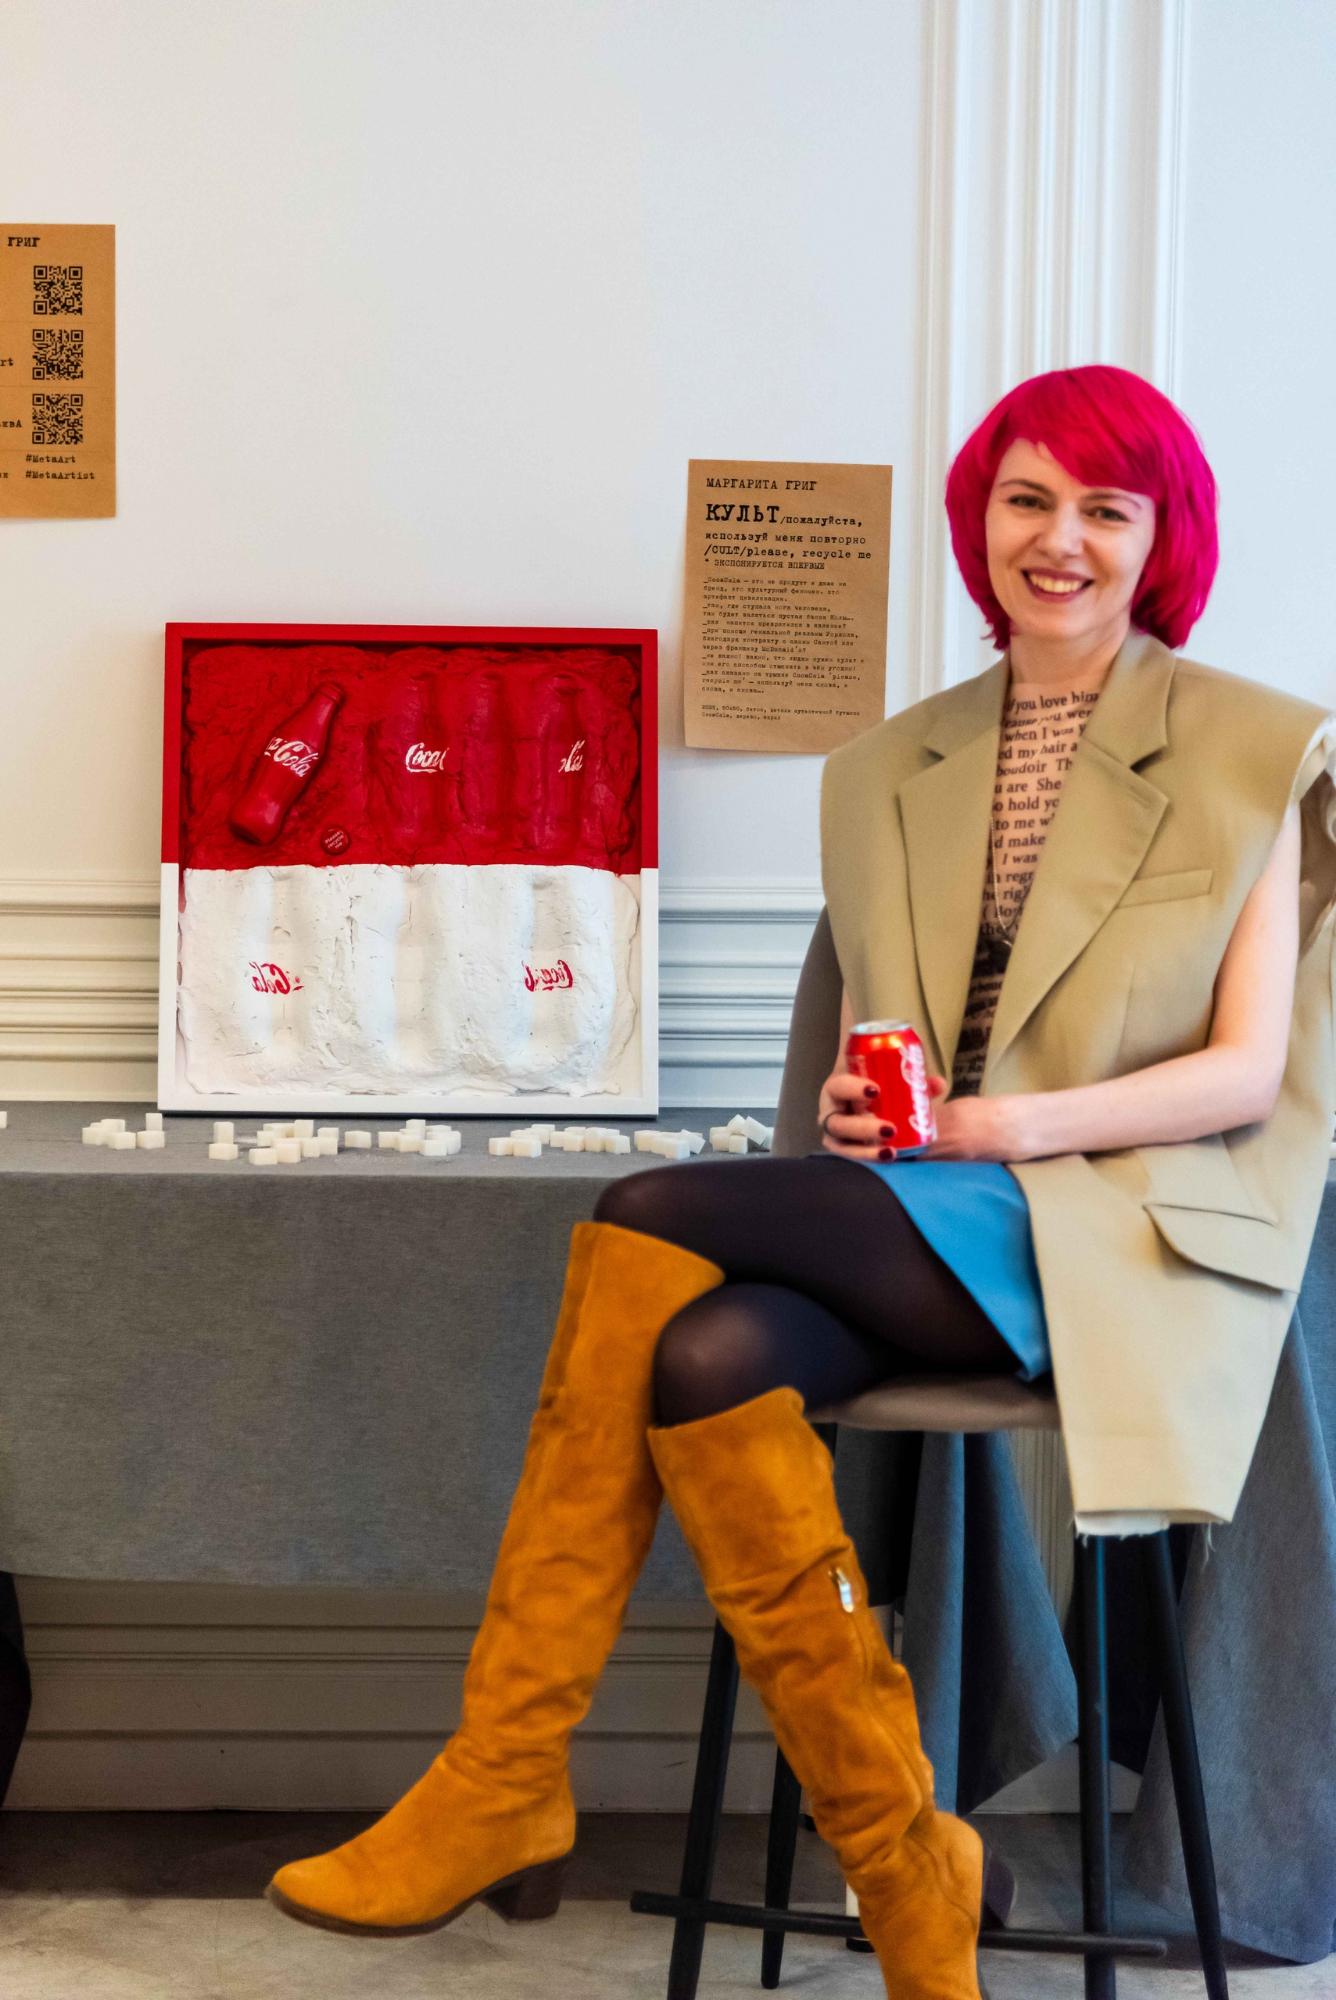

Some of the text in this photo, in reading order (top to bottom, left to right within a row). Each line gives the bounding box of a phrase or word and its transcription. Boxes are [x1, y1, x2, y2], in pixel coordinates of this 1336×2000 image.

[7, 236, 40, 247] ГРИГ
[706, 478, 818, 491] МАРГАРИТА ГРИГ
[705, 532, 866, 545] используй меня повторно
[802, 549, 851, 560] recycle
[1015, 700, 1037, 715] you
[1040, 695, 1068, 708] love
[1005, 729, 1038, 742] when
[1042, 727, 1047, 739] I
[1018, 749, 1036, 759] my
[1040, 741, 1067, 754] hair
[997, 759, 1047, 777] boudoir
[1006, 782, 1028, 792] are
[1036, 777, 1062, 791] She
[1008, 796, 1040, 811] hold
[1014, 818, 1035, 829] me
[1008, 833, 1046, 847] make
[1012, 854, 1038, 864] was
